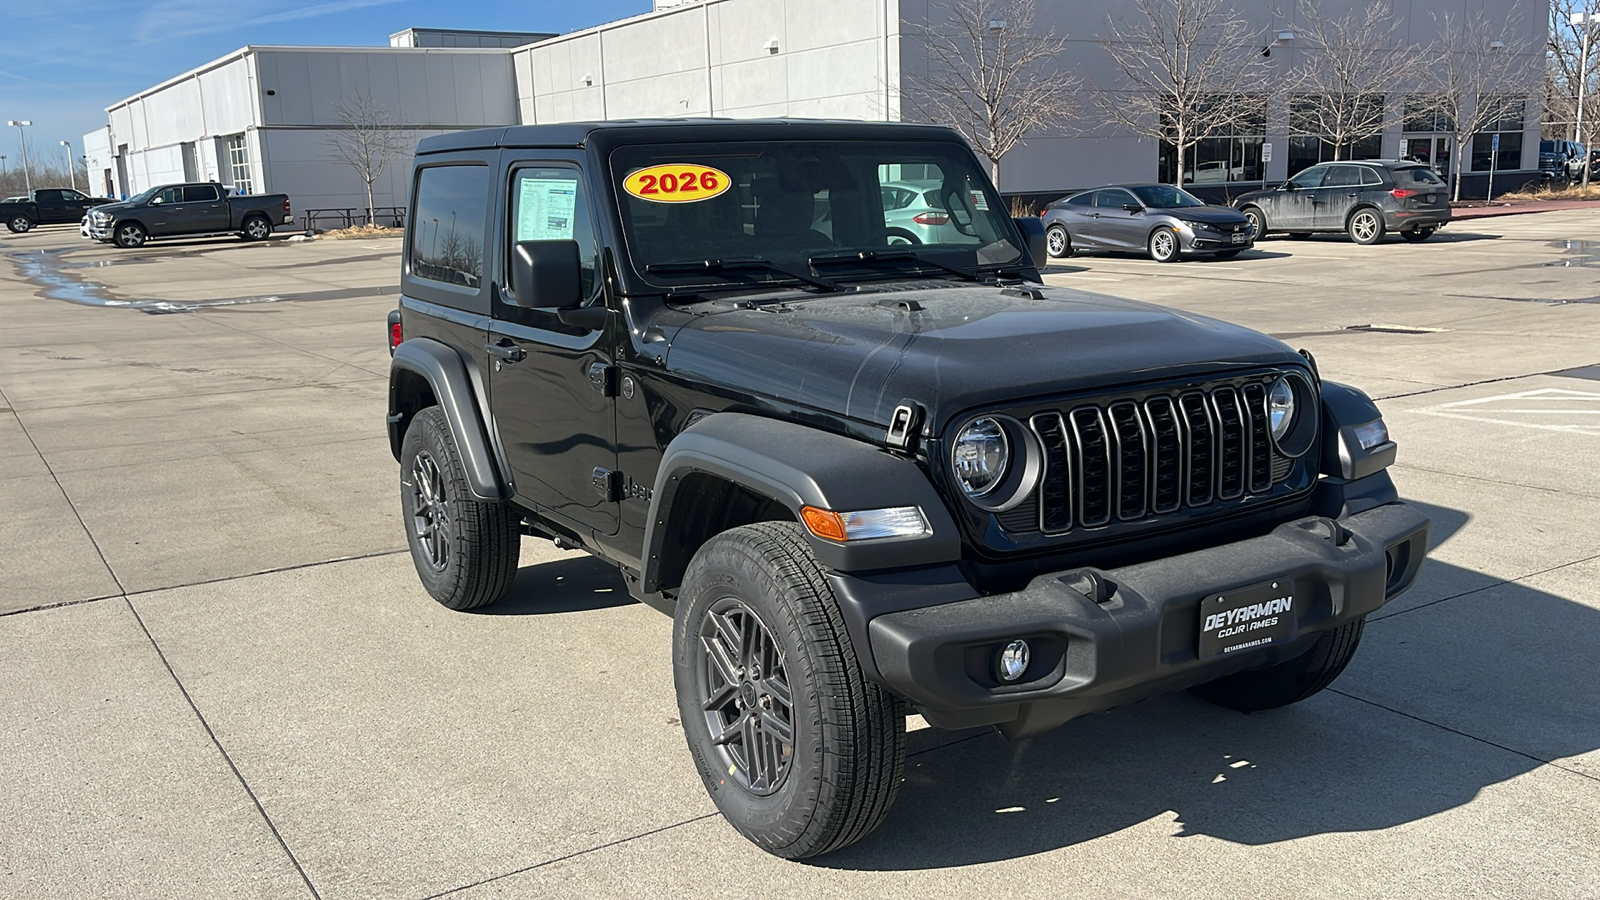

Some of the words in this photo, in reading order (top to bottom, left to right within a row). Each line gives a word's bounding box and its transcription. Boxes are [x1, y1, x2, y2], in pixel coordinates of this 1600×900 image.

[639, 171, 719, 195] 2026
[1204, 597, 1292, 632] DEYARMAN
[1217, 625, 1245, 638] CDJR
[1249, 617, 1278, 631] AMES
[1224, 637, 1272, 653] DEYARMANAMES.COM
